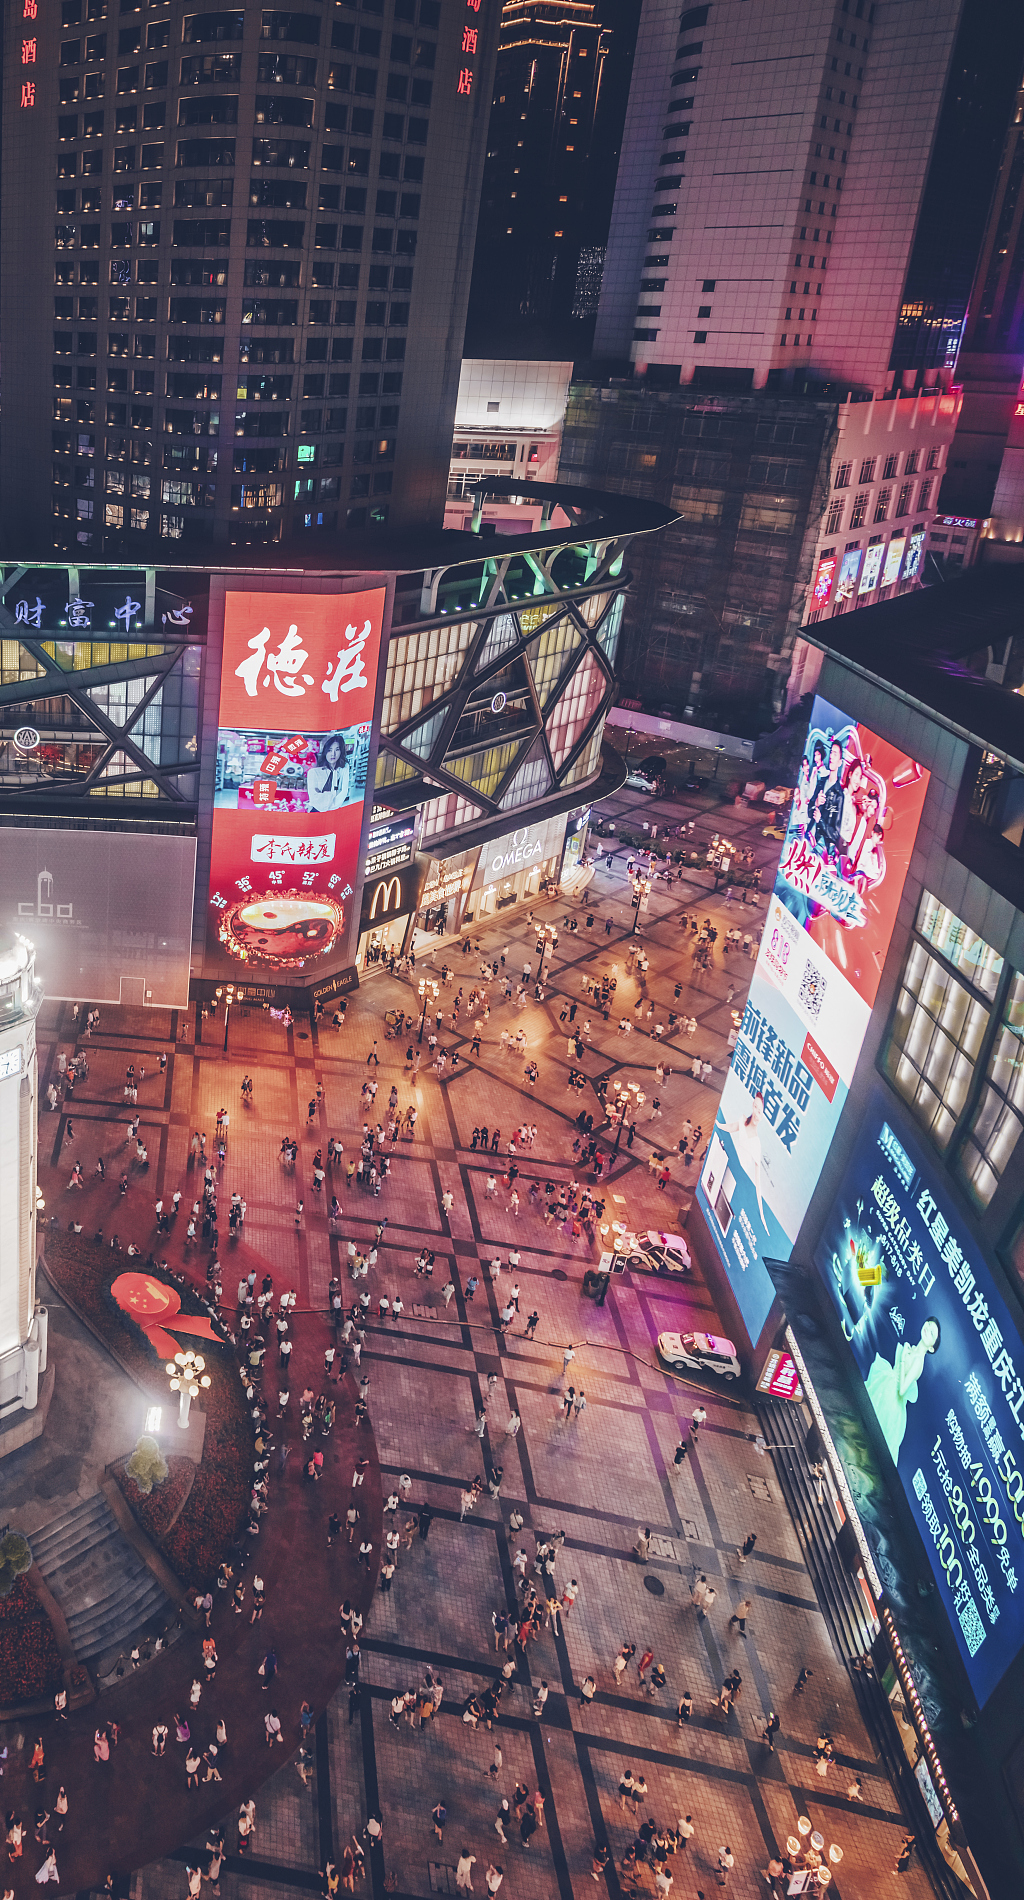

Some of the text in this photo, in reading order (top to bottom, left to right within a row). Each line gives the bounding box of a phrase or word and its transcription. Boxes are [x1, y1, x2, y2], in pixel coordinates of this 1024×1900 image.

[491, 840, 542, 872] OMEGA
[234, 875, 251, 889] 36°
[268, 870, 286, 880] 45°
[302, 871, 320, 882] 52°
[313, 975, 353, 998] GOLDEN EAGLE
[741, 1000, 814, 1113] 前锋新品
[871, 1174, 936, 1297] 超级品类日
[915, 1189, 1024, 1442] 红星美凯龙重庆江
